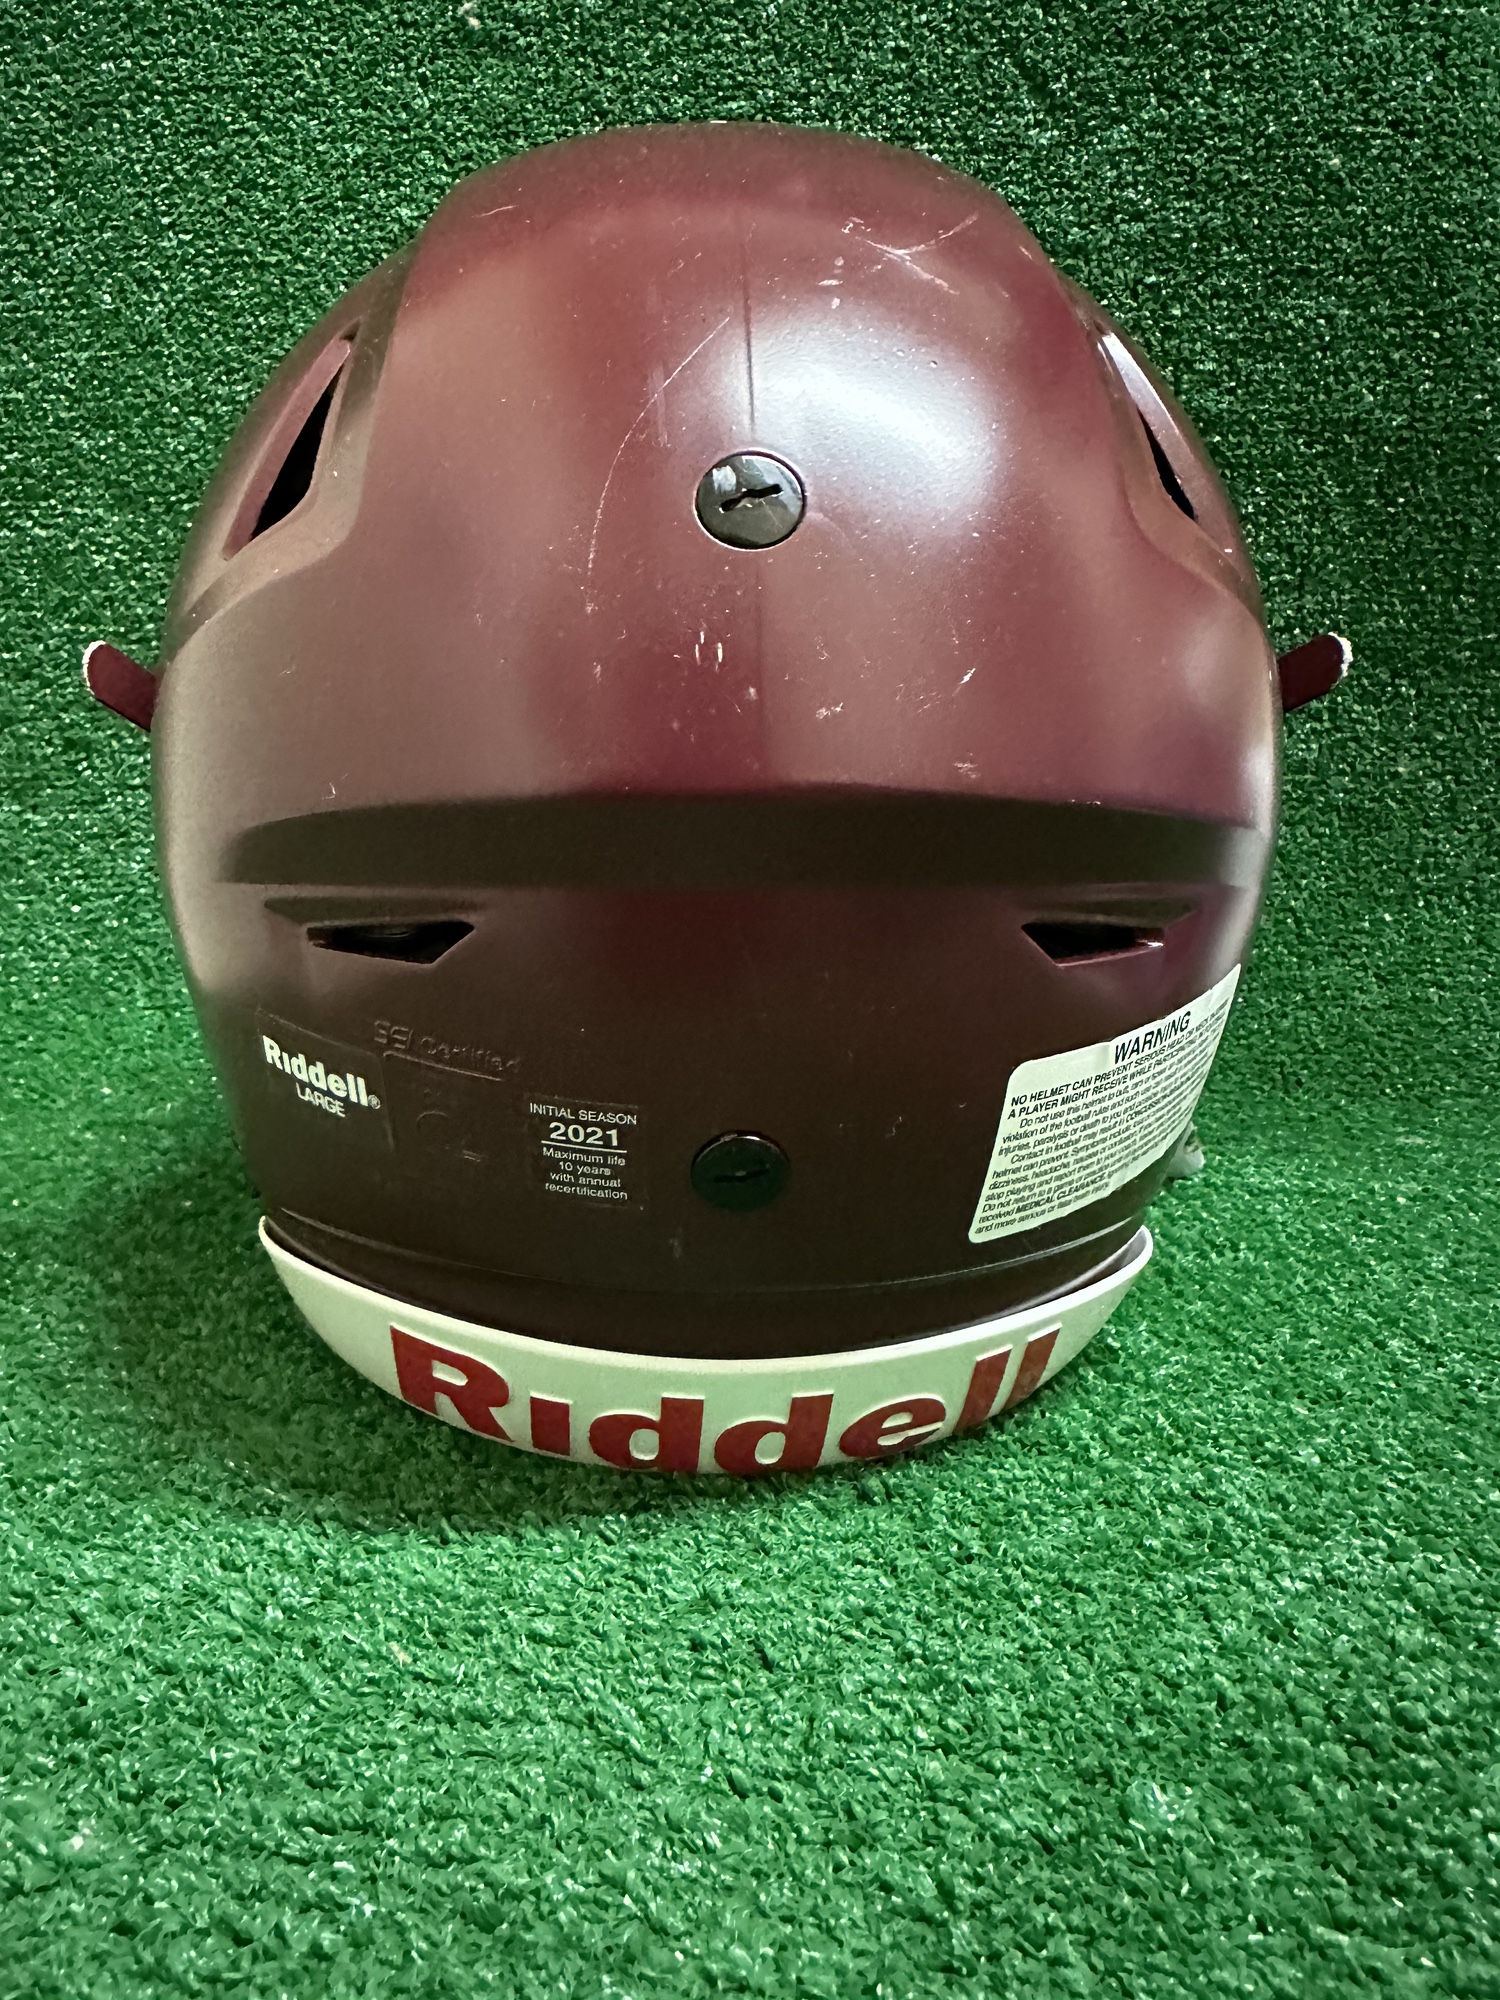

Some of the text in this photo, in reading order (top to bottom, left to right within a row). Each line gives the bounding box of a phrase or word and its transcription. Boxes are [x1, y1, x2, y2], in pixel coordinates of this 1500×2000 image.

[1115, 1011, 1191, 1064] WARNING
[1007, 1109, 1016, 1120] A
[1018, 1098, 1059, 1117] PLAYER
[1060, 1089, 1091, 1107] MIGHT
[1091, 1074, 1129, 1096] RECEIVE
[1129, 1063, 1153, 1081] WHILE
[1011, 1094, 1028, 1107] NO
[1029, 1083, 1072, 1102] HELMET
[1072, 1076, 1093, 1091] CAN
[1094, 1061, 1134, 1084] PREVENT
[295, 1081, 346, 1118] LARGE
[529, 1102, 637, 1125] INITIAL SEASON
[549, 1121, 618, 1147] 2021
[542, 1147, 626, 1166] Maximum life
[559, 1161, 611, 1175] 10 years
[545, 1182, 628, 1200] recertification
[550, 1172, 621, 1188] with annual
[389, 1323, 1062, 1473] Riddell
